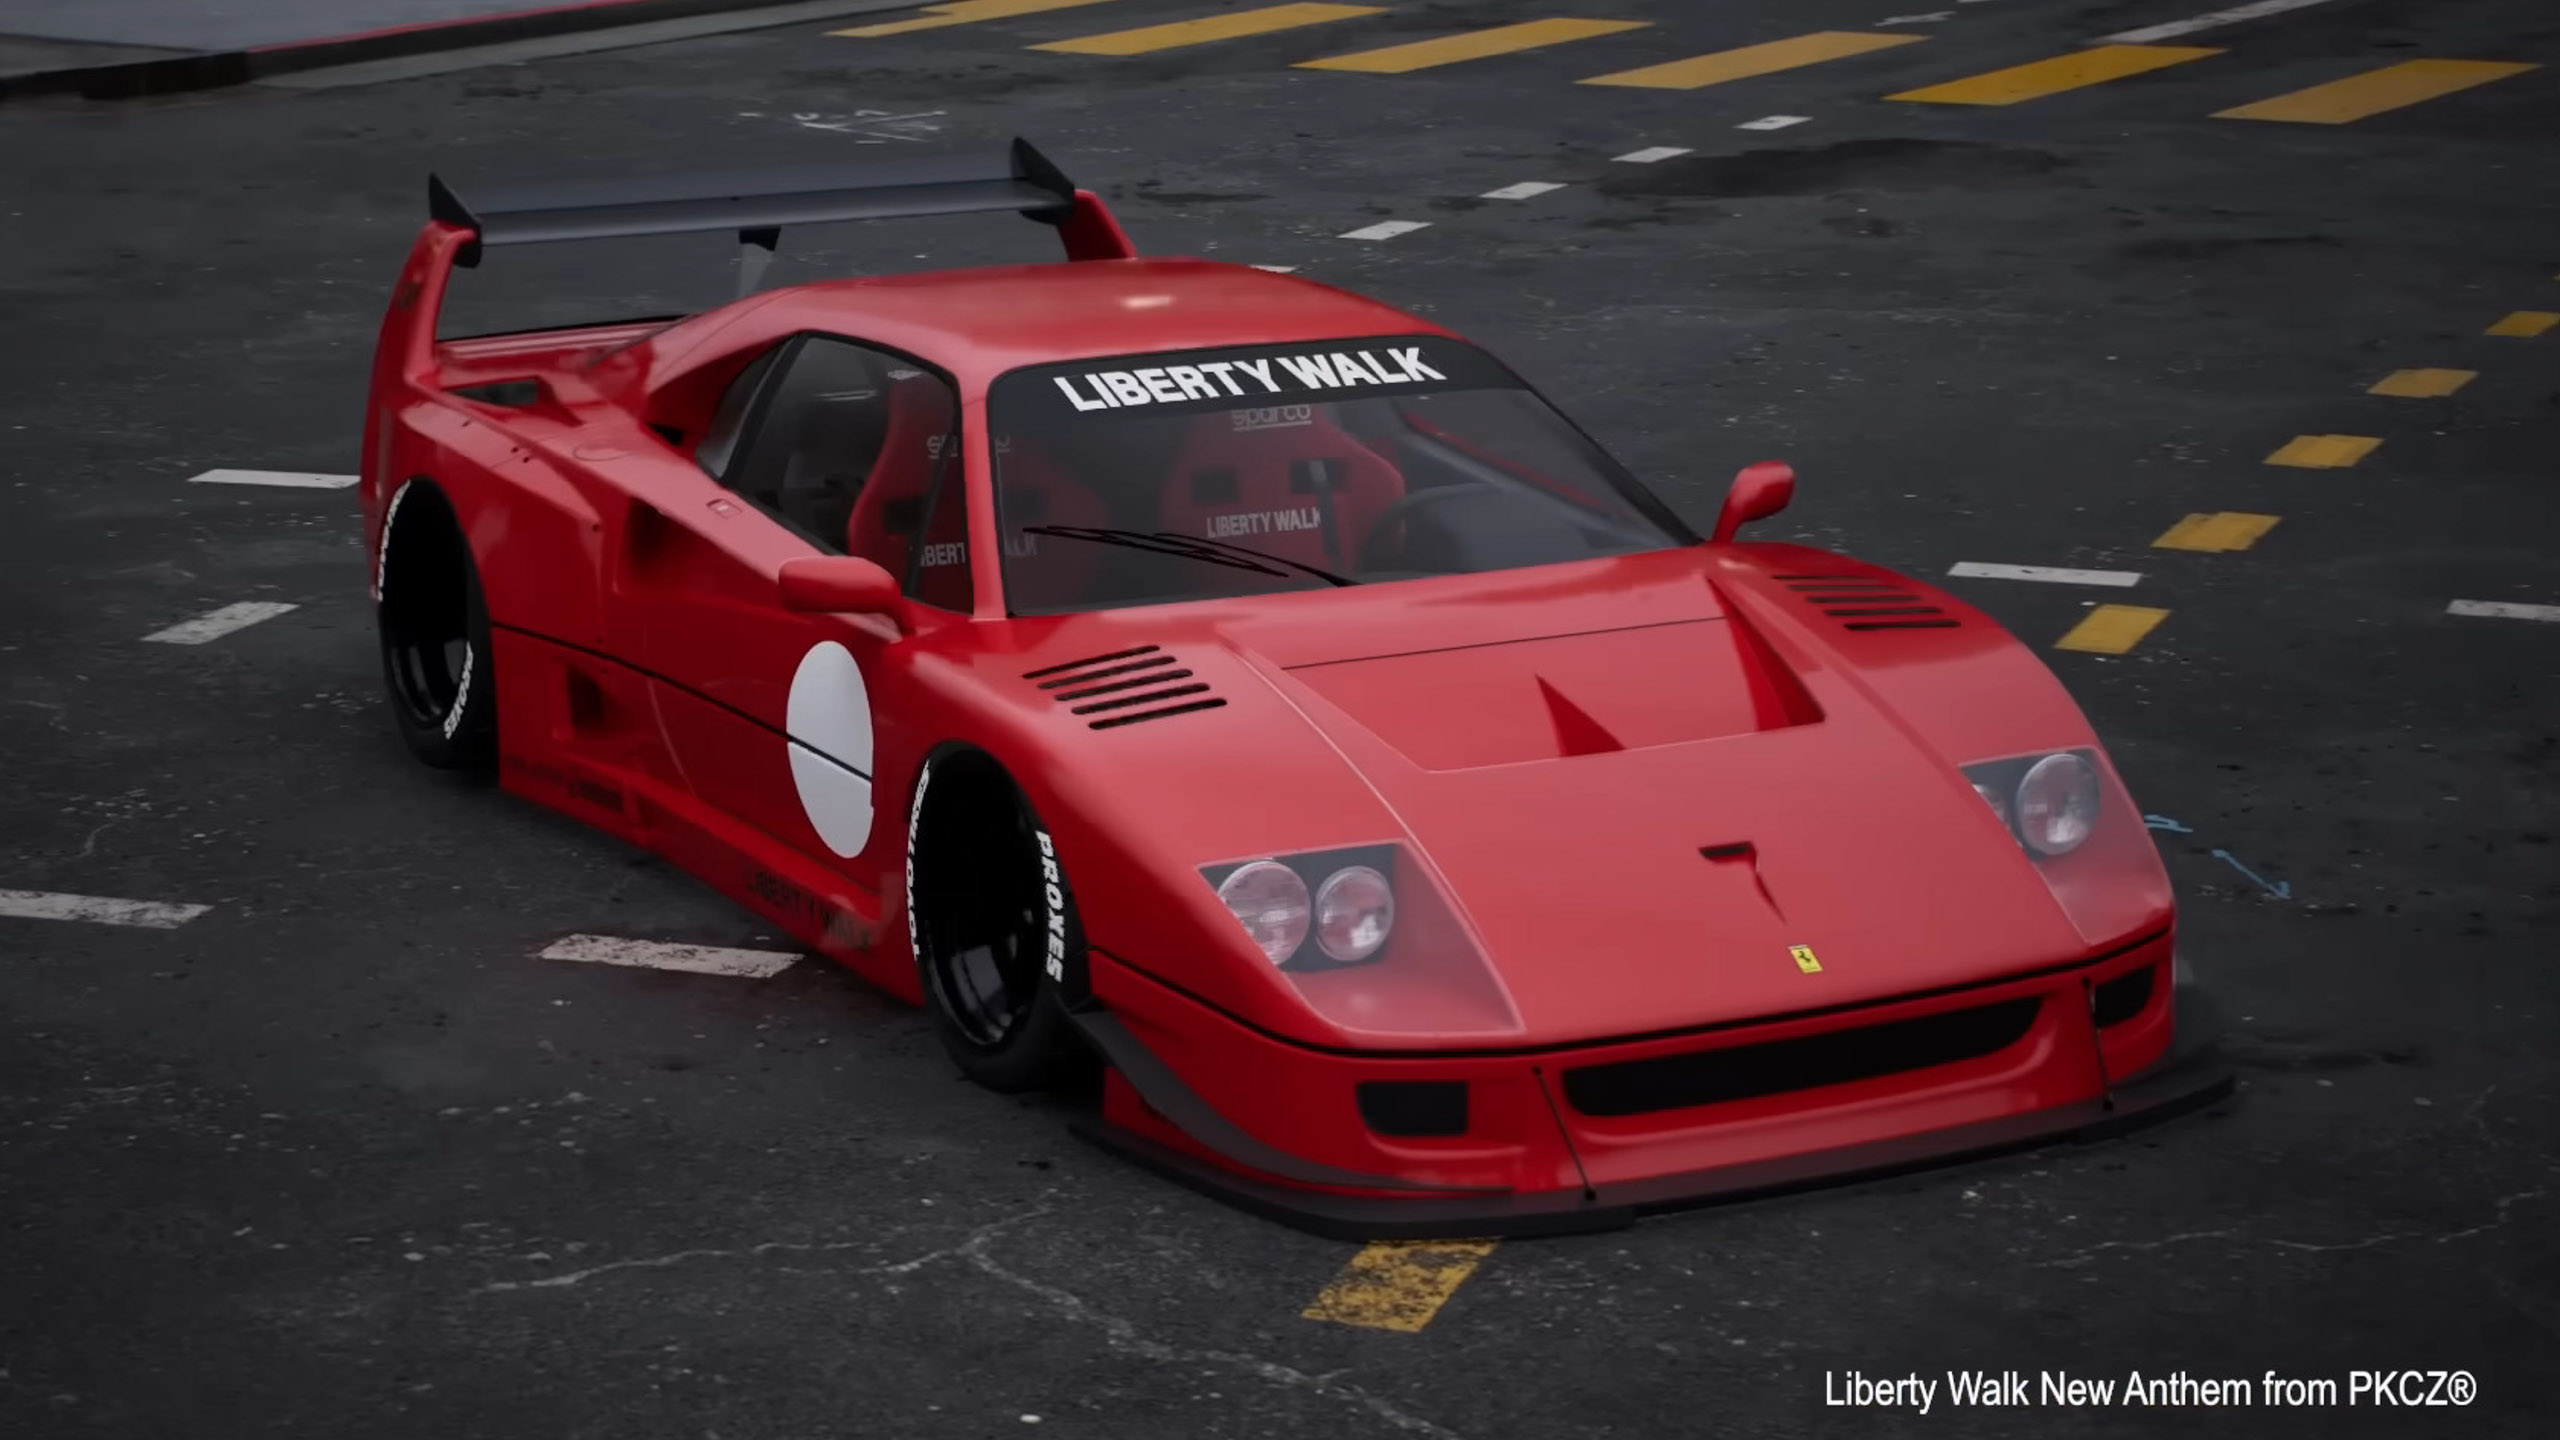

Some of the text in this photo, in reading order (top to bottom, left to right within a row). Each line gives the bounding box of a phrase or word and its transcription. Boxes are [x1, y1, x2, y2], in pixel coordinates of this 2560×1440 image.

[1052, 346, 1448, 413] LIBERTY WALK
[1206, 511, 1271, 538] LIBERTY
[1036, 830, 1065, 982] PROXES
